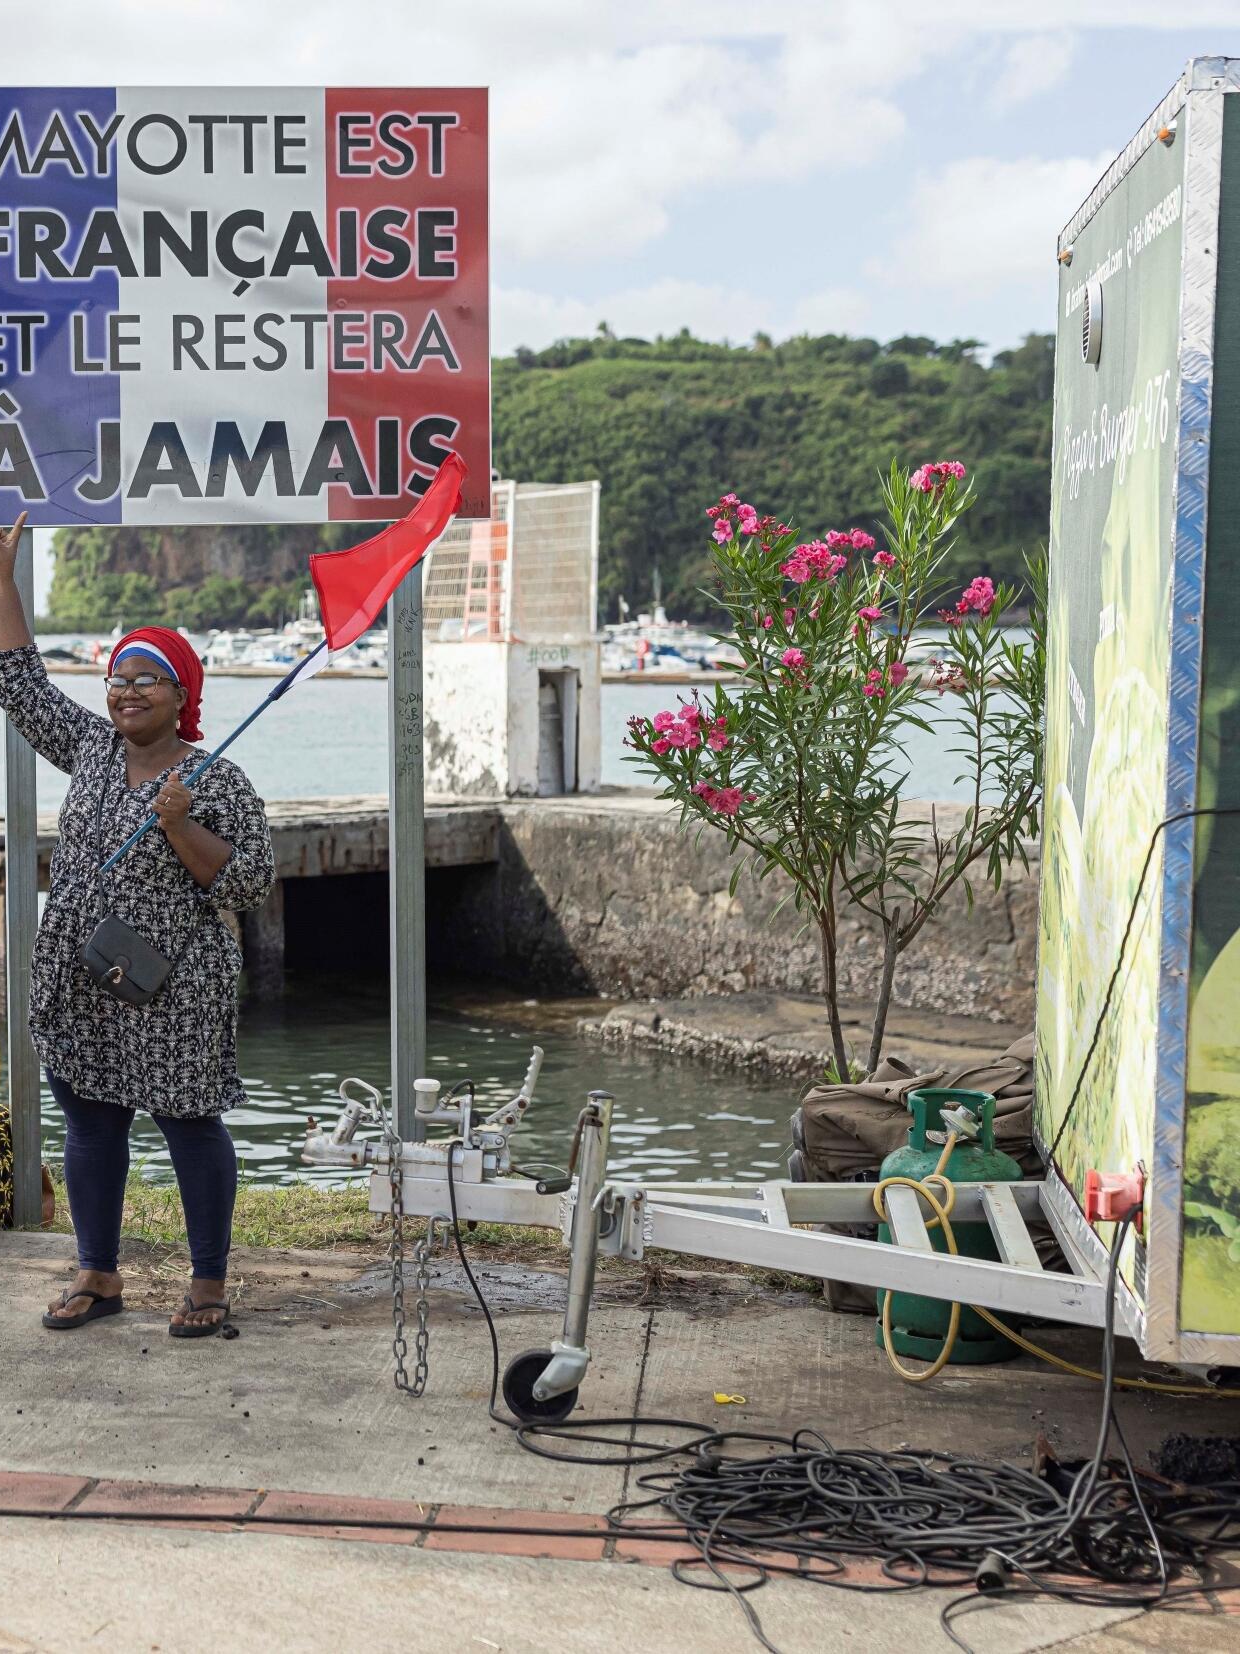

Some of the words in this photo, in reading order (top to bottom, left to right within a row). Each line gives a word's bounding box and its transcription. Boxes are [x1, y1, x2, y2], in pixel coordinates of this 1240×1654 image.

[339, 114, 457, 175] EST
[73, 314, 142, 372] LE
[172, 311, 459, 371] RESTERA
[76, 417, 459, 500] JAMAIS
[1062, 423, 1088, 500] Pizza
[1100, 402, 1142, 485] Burger
[1143, 369, 1170, 450] 976
